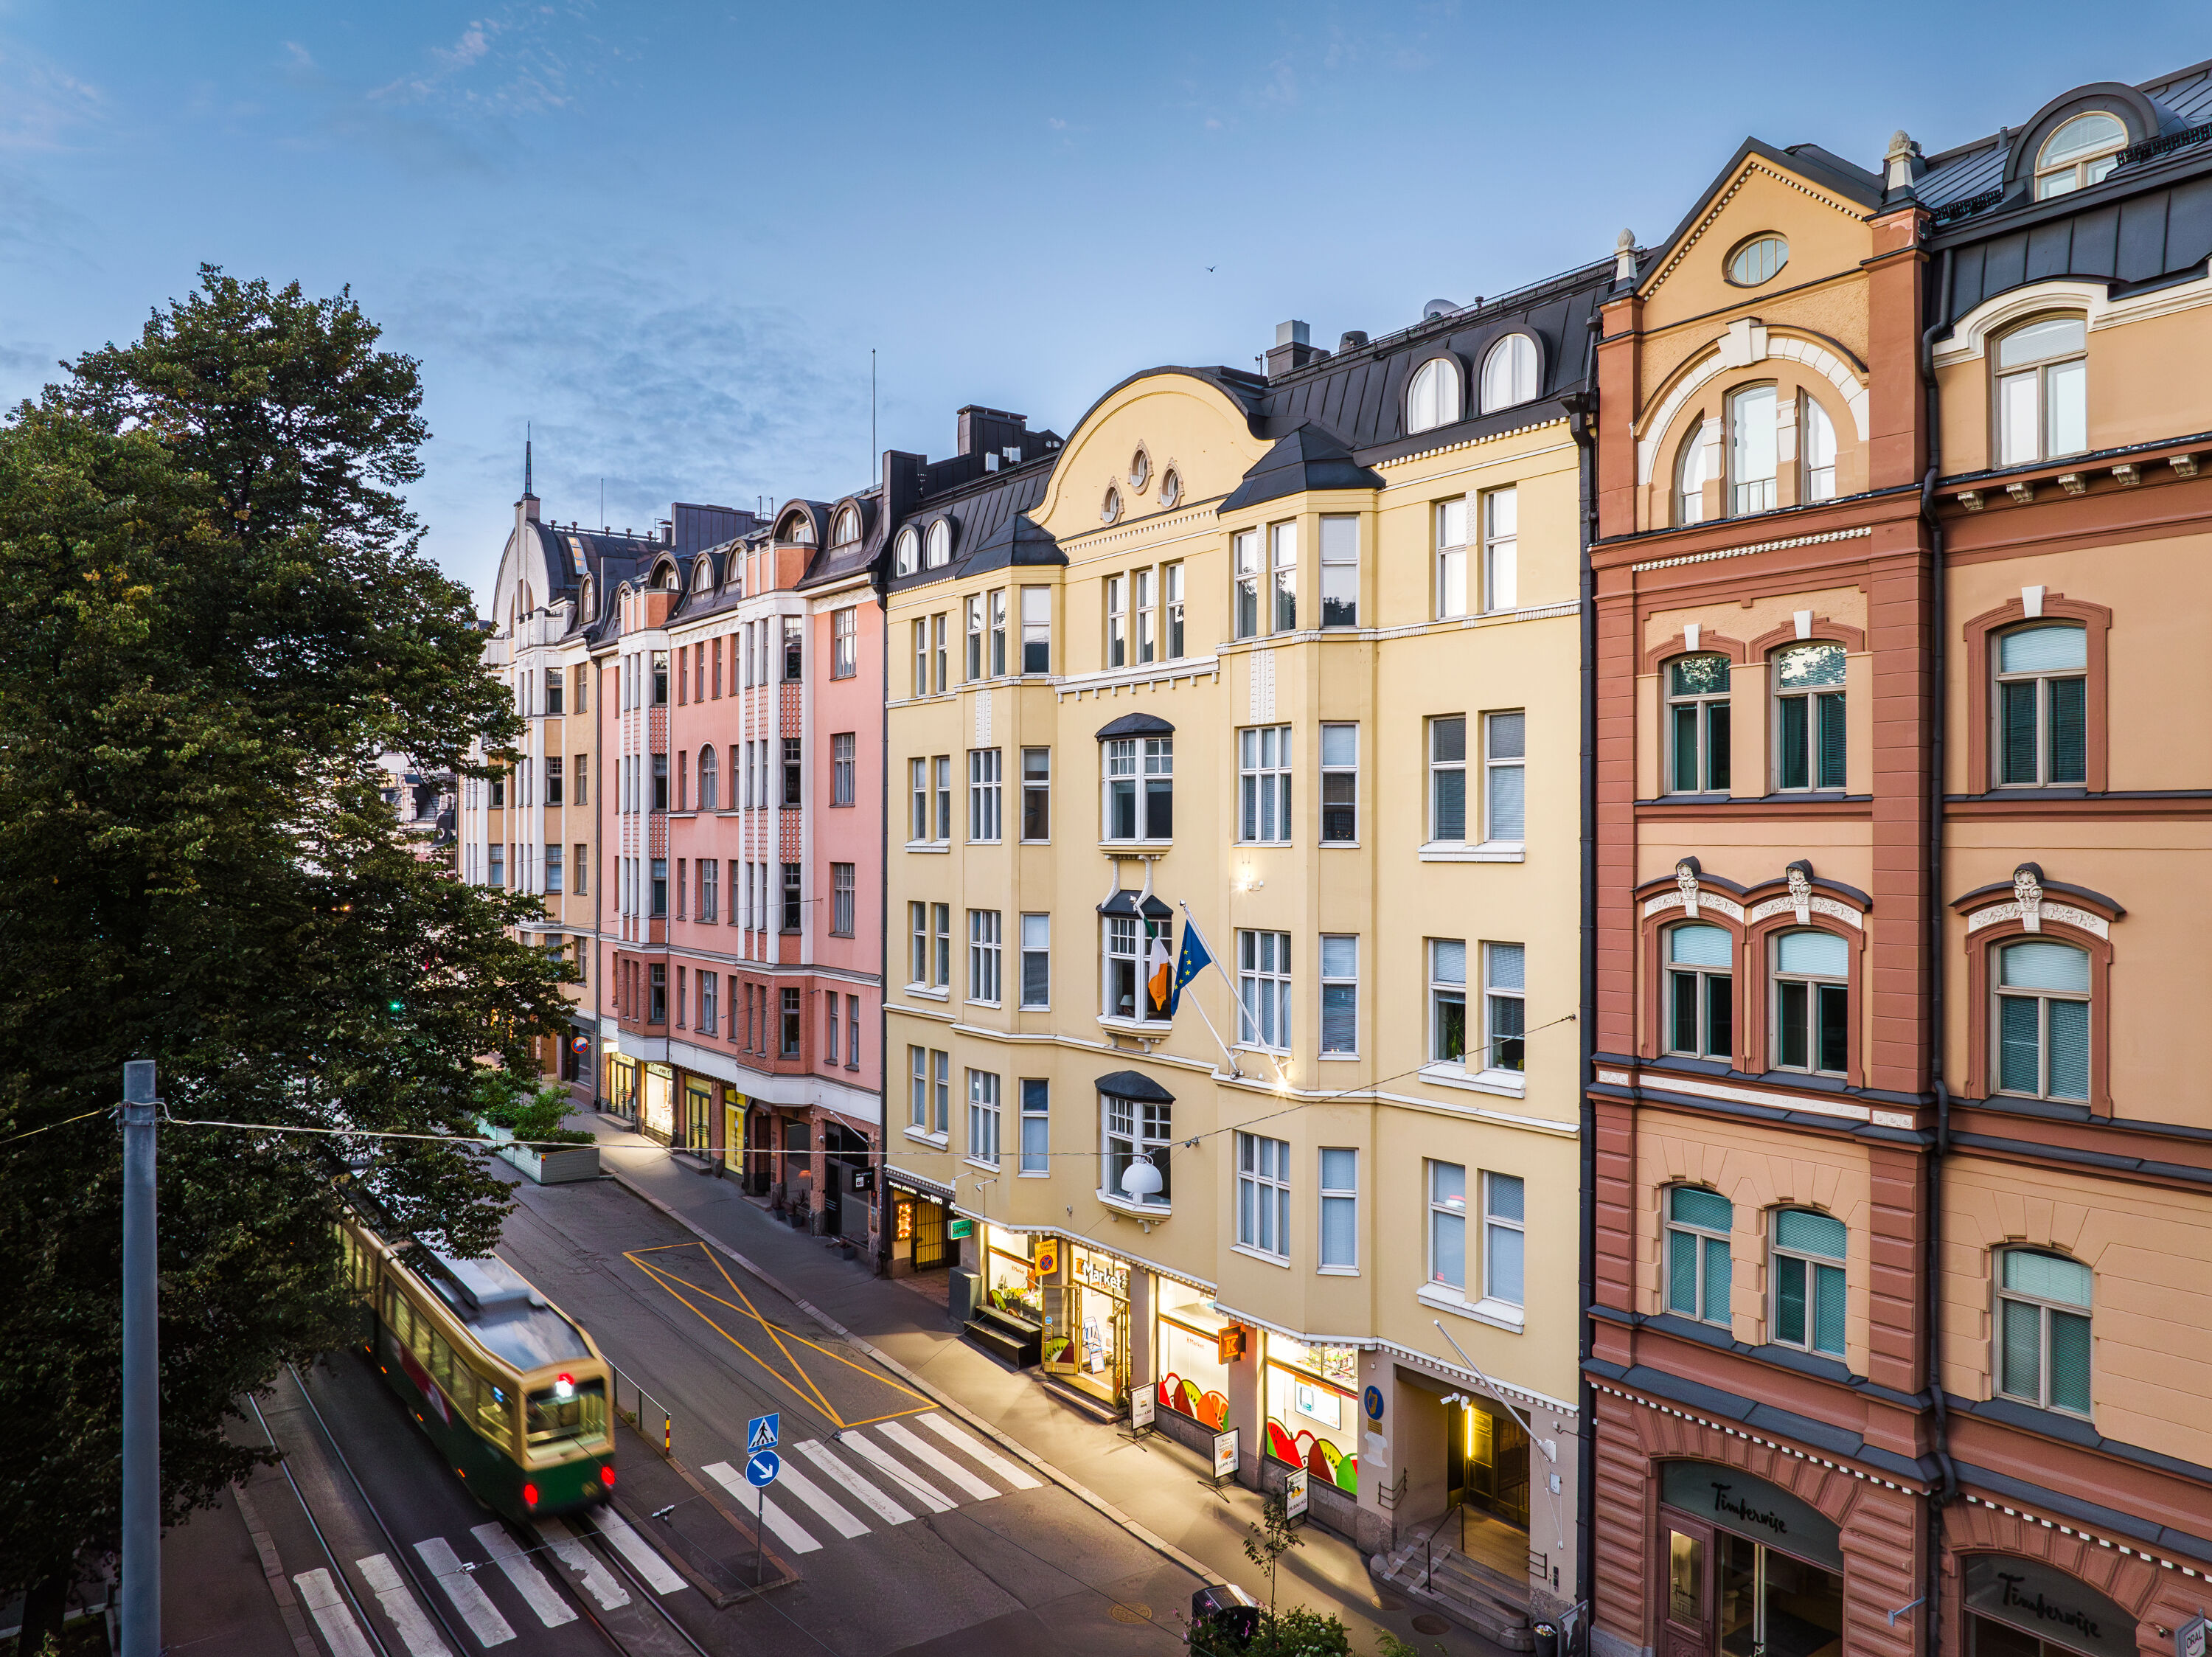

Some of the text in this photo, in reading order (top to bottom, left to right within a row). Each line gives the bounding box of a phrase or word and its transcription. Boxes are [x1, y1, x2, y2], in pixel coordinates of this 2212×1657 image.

[953, 1226, 972, 1235] SAMPO
[1083, 1261, 1122, 1290] Market
[1224, 1335, 1238, 1355] K
[1711, 1482, 1787, 1533] Timberwise
[1997, 1572, 2101, 1637] Timberwise
[2186, 1629, 2202, 1649] ORAL
